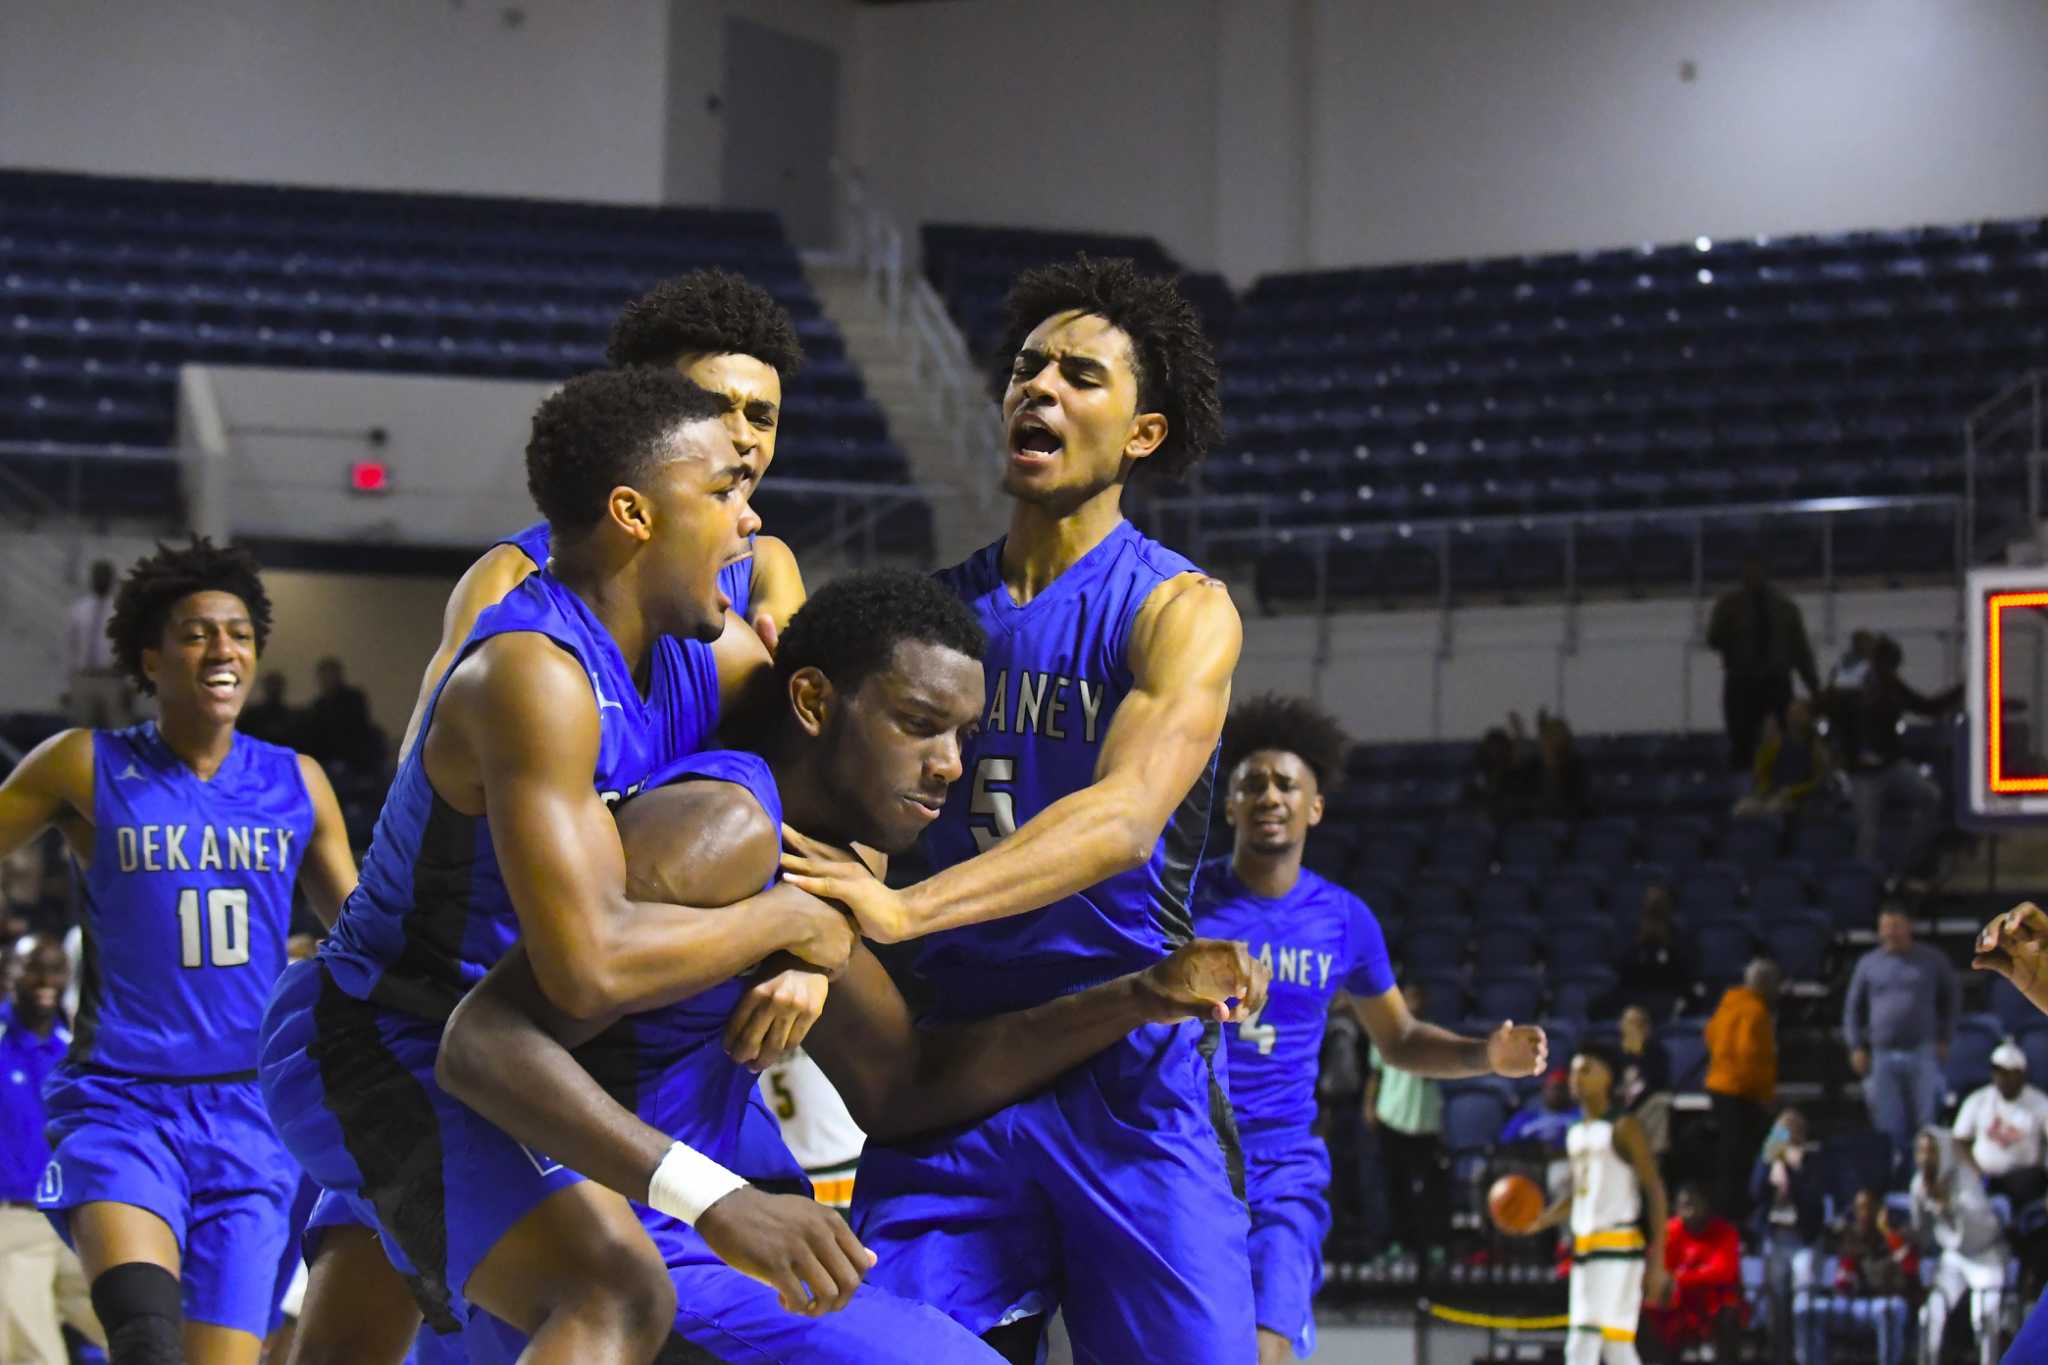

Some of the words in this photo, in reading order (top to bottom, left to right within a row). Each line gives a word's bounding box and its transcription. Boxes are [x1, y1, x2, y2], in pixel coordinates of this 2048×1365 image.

[984, 669, 1104, 742] ANEY
[969, 757, 1017, 854] 5
[117, 824, 294, 872] DEKANEY
[178, 888, 249, 968] 10
[770, 1071, 795, 1120] 5
